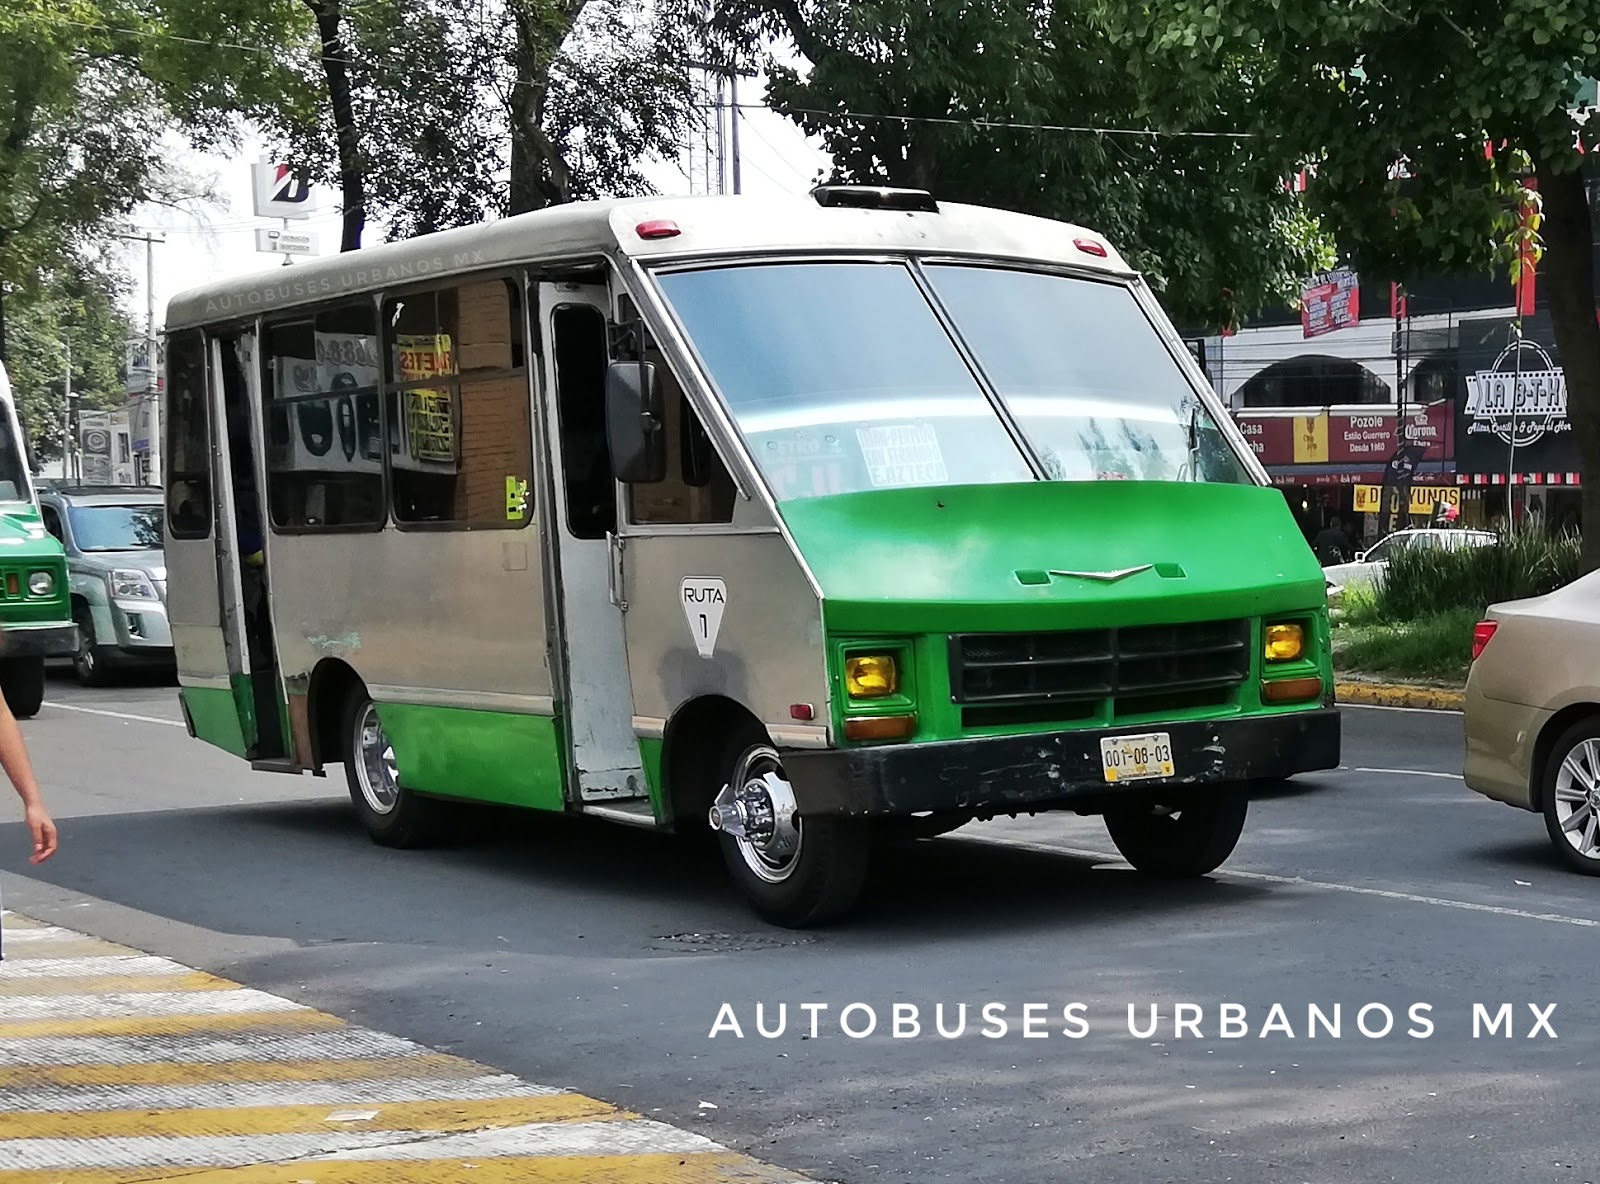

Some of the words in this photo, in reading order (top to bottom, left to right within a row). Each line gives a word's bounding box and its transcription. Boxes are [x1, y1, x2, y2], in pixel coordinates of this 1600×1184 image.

[1485, 380, 1506, 408] LA
[1240, 422, 1264, 435] Casa
[1350, 416, 1384, 428] Pozole
[1344, 431, 1362, 441] Estilo
[1363, 430, 1391, 440] Guerrero
[1405, 423, 1438, 440] Corona
[1248, 440, 1265, 453] cha
[684, 588, 725, 603] RUTA
[699, 613, 708, 639] 1
[1105, 744, 1170, 767] 001-08-03
